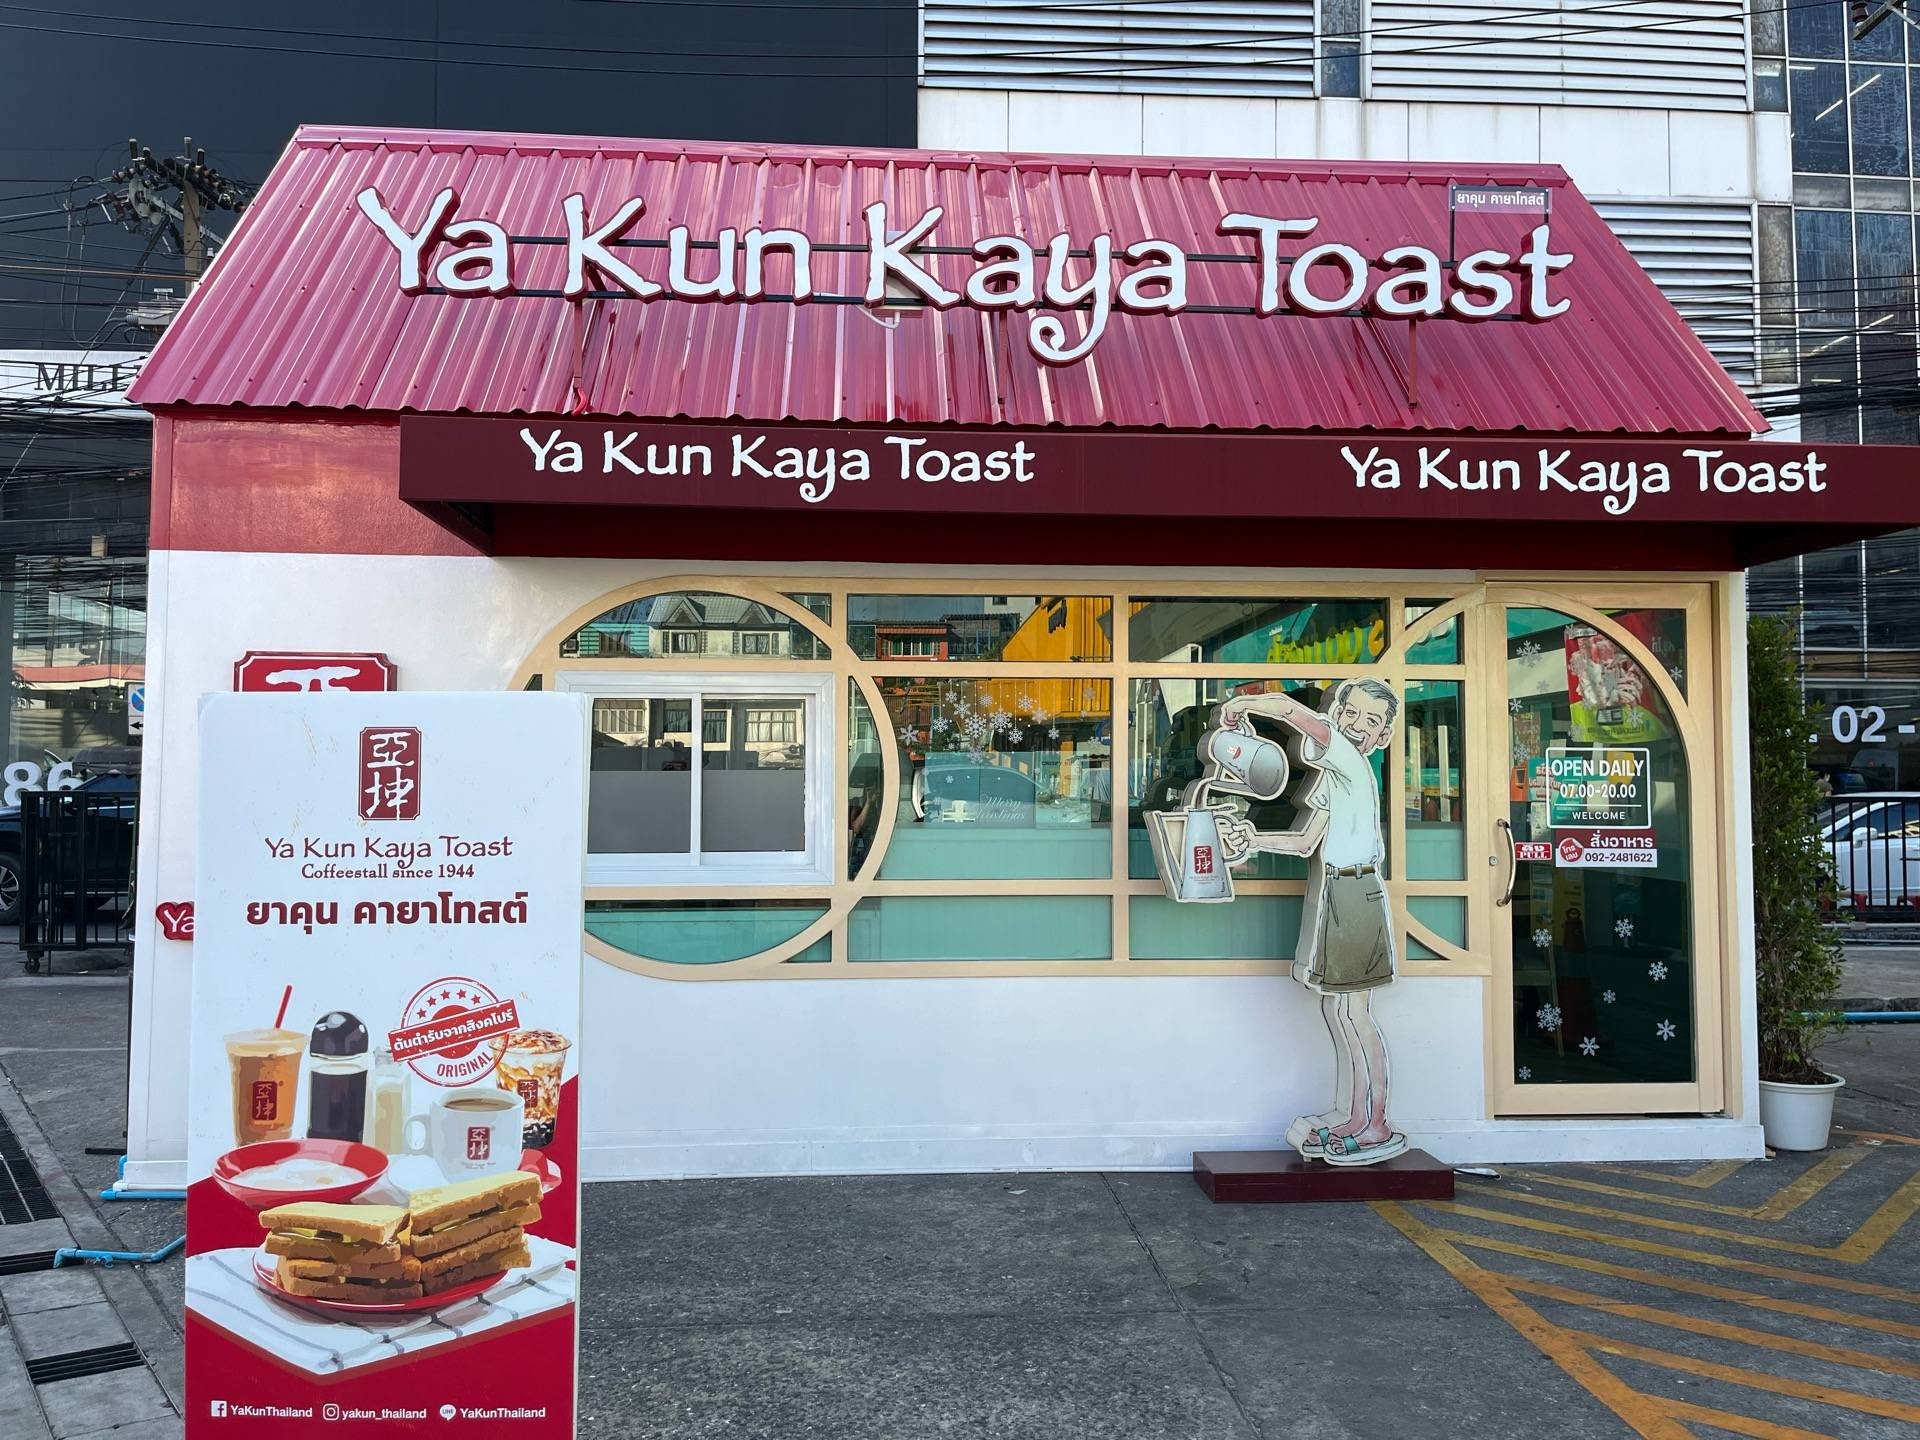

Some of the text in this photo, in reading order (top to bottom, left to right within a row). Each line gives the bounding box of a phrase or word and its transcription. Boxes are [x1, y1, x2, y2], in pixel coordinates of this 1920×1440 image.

[1457, 193, 1486, 207] ยาคุน
[357, 187, 1574, 361] Ya Kun Kaya Toast
[34, 362, 142, 391] MILL
[519, 427, 1036, 503] Ya Kun Kaya Toast
[1340, 445, 1827, 516] Ya Kun Kaya Toast
[1831, 705, 1887, 743] 02
[1551, 759, 1595, 777] OPEN
[1599, 759, 1644, 777] DAILY
[1559, 783, 1637, 799] 07.00-20.00
[1572, 811, 1626, 820] WELCOME
[1590, 829, 1654, 848] สั่งอาหาร
[264, 835, 514, 870] Ya Kun Kaya Toast
[1519, 851, 1548, 859] PULL
[1585, 852, 1653, 862] 092-2481622
[301, 863, 475, 879] Coffeestall since 1944
[246, 901, 339, 935] ยาคุน
[436, 1051, 494, 1078] ORIGINAL
[231, 1404, 313, 1418] YaKunThailand
[342, 1408, 427, 1421] yakun_thailand
[460, 1407, 546, 1419] YaKunThailand
